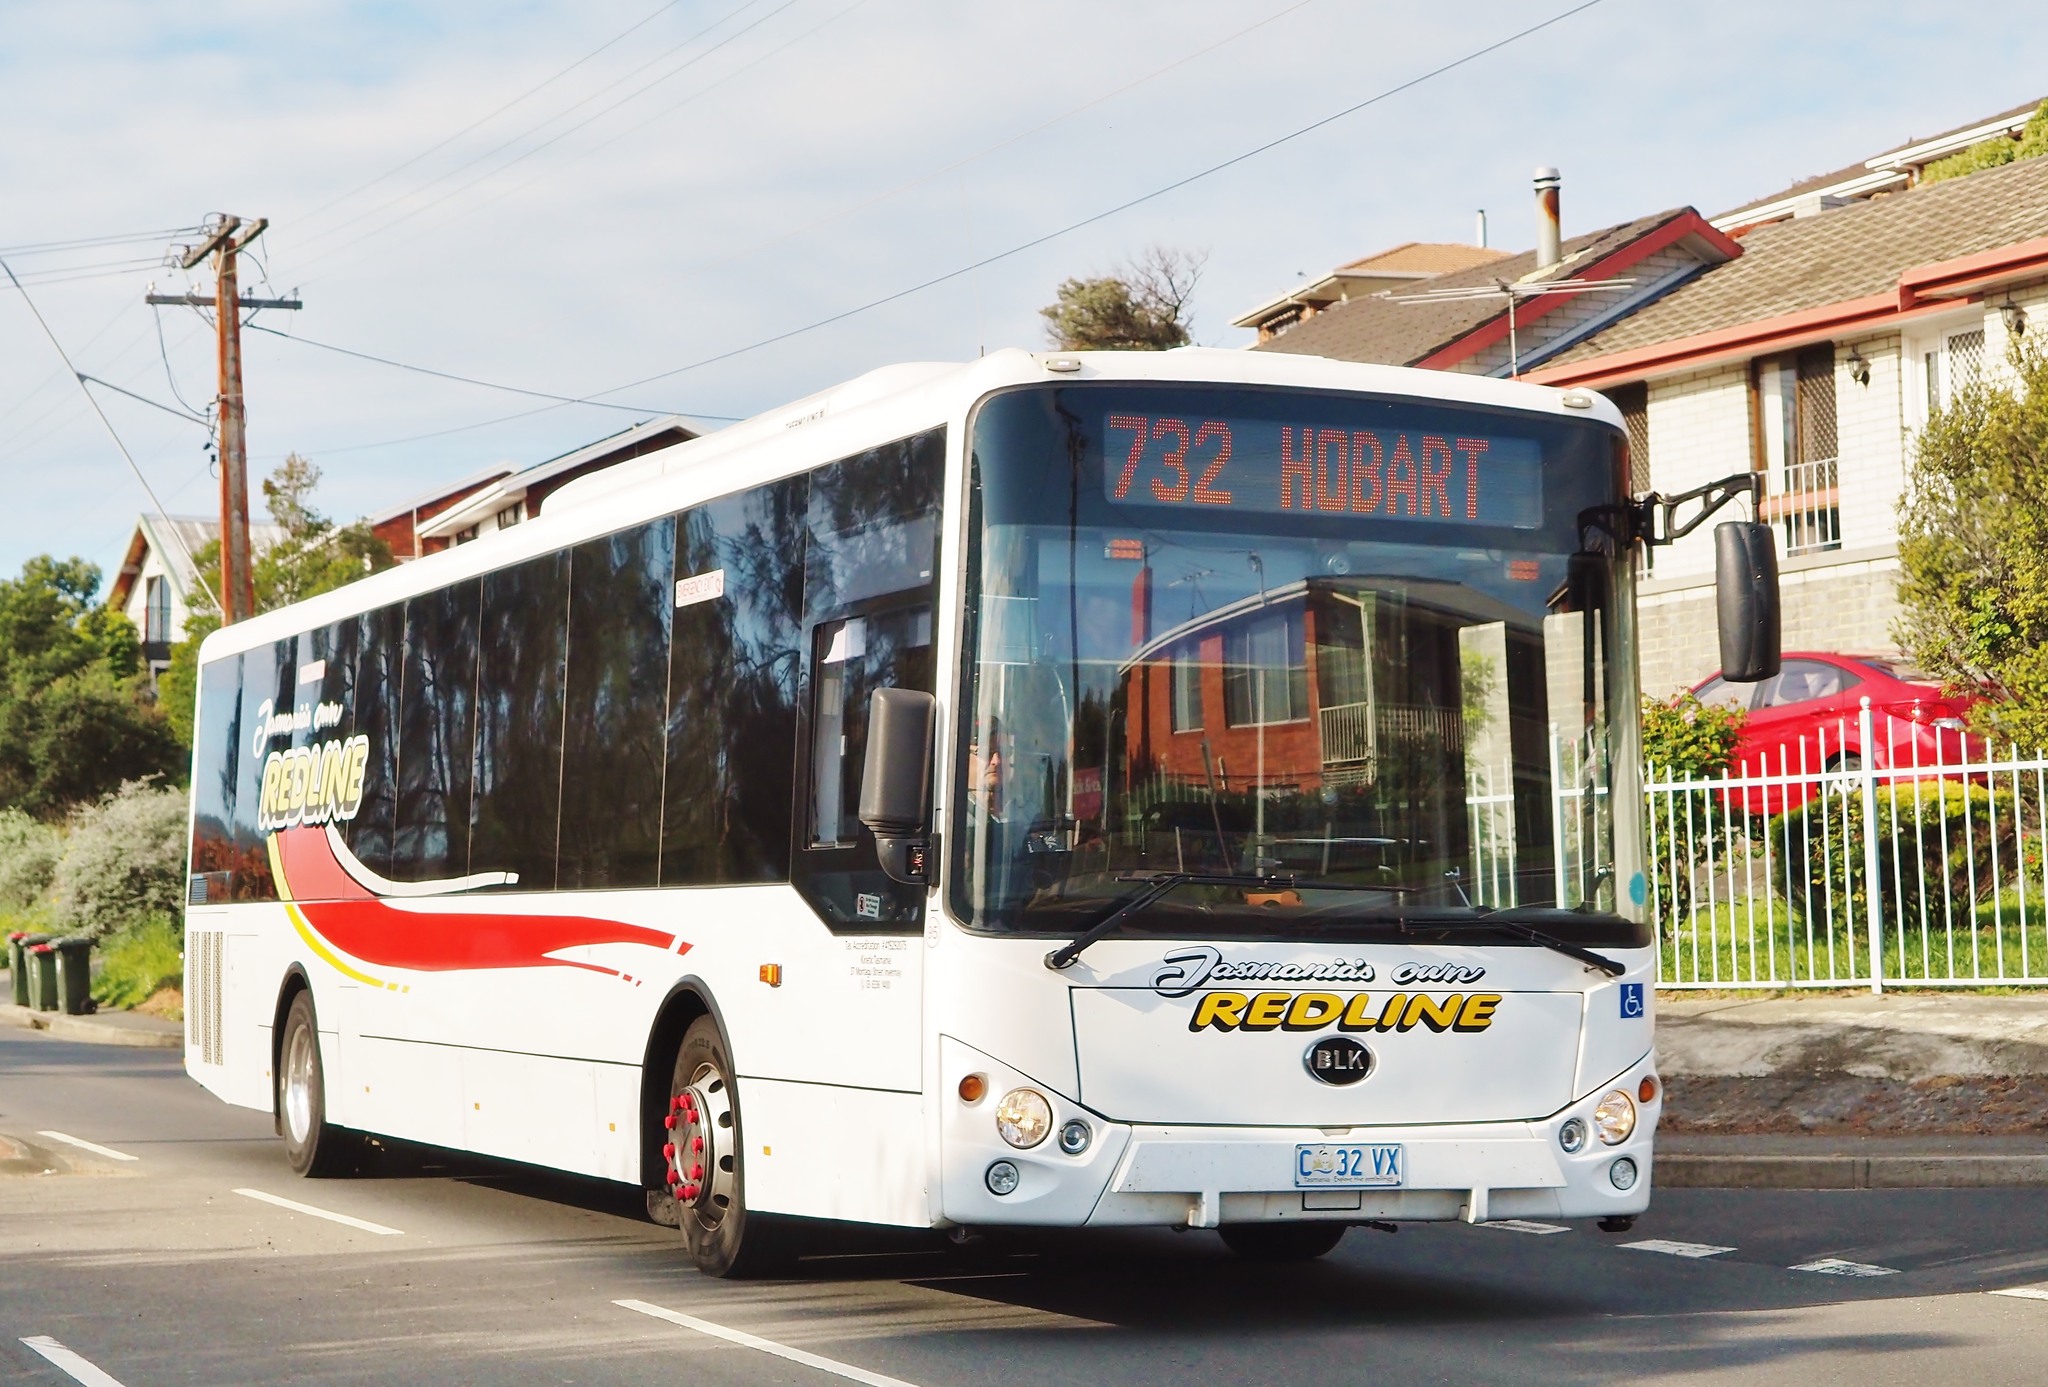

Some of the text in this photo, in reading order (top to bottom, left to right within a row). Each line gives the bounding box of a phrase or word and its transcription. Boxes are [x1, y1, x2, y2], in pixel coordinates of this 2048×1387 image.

[1110, 415, 1489, 519] 732 HOBART
[260, 738, 368, 826] REDLINE
[1150, 946, 1486, 998] Tasmania's own
[1188, 992, 1502, 1033] REDLINE
[1316, 1050, 1364, 1070] BLK
[1336, 1149, 1362, 1176] 32
[1372, 1148, 1398, 1175] VX
